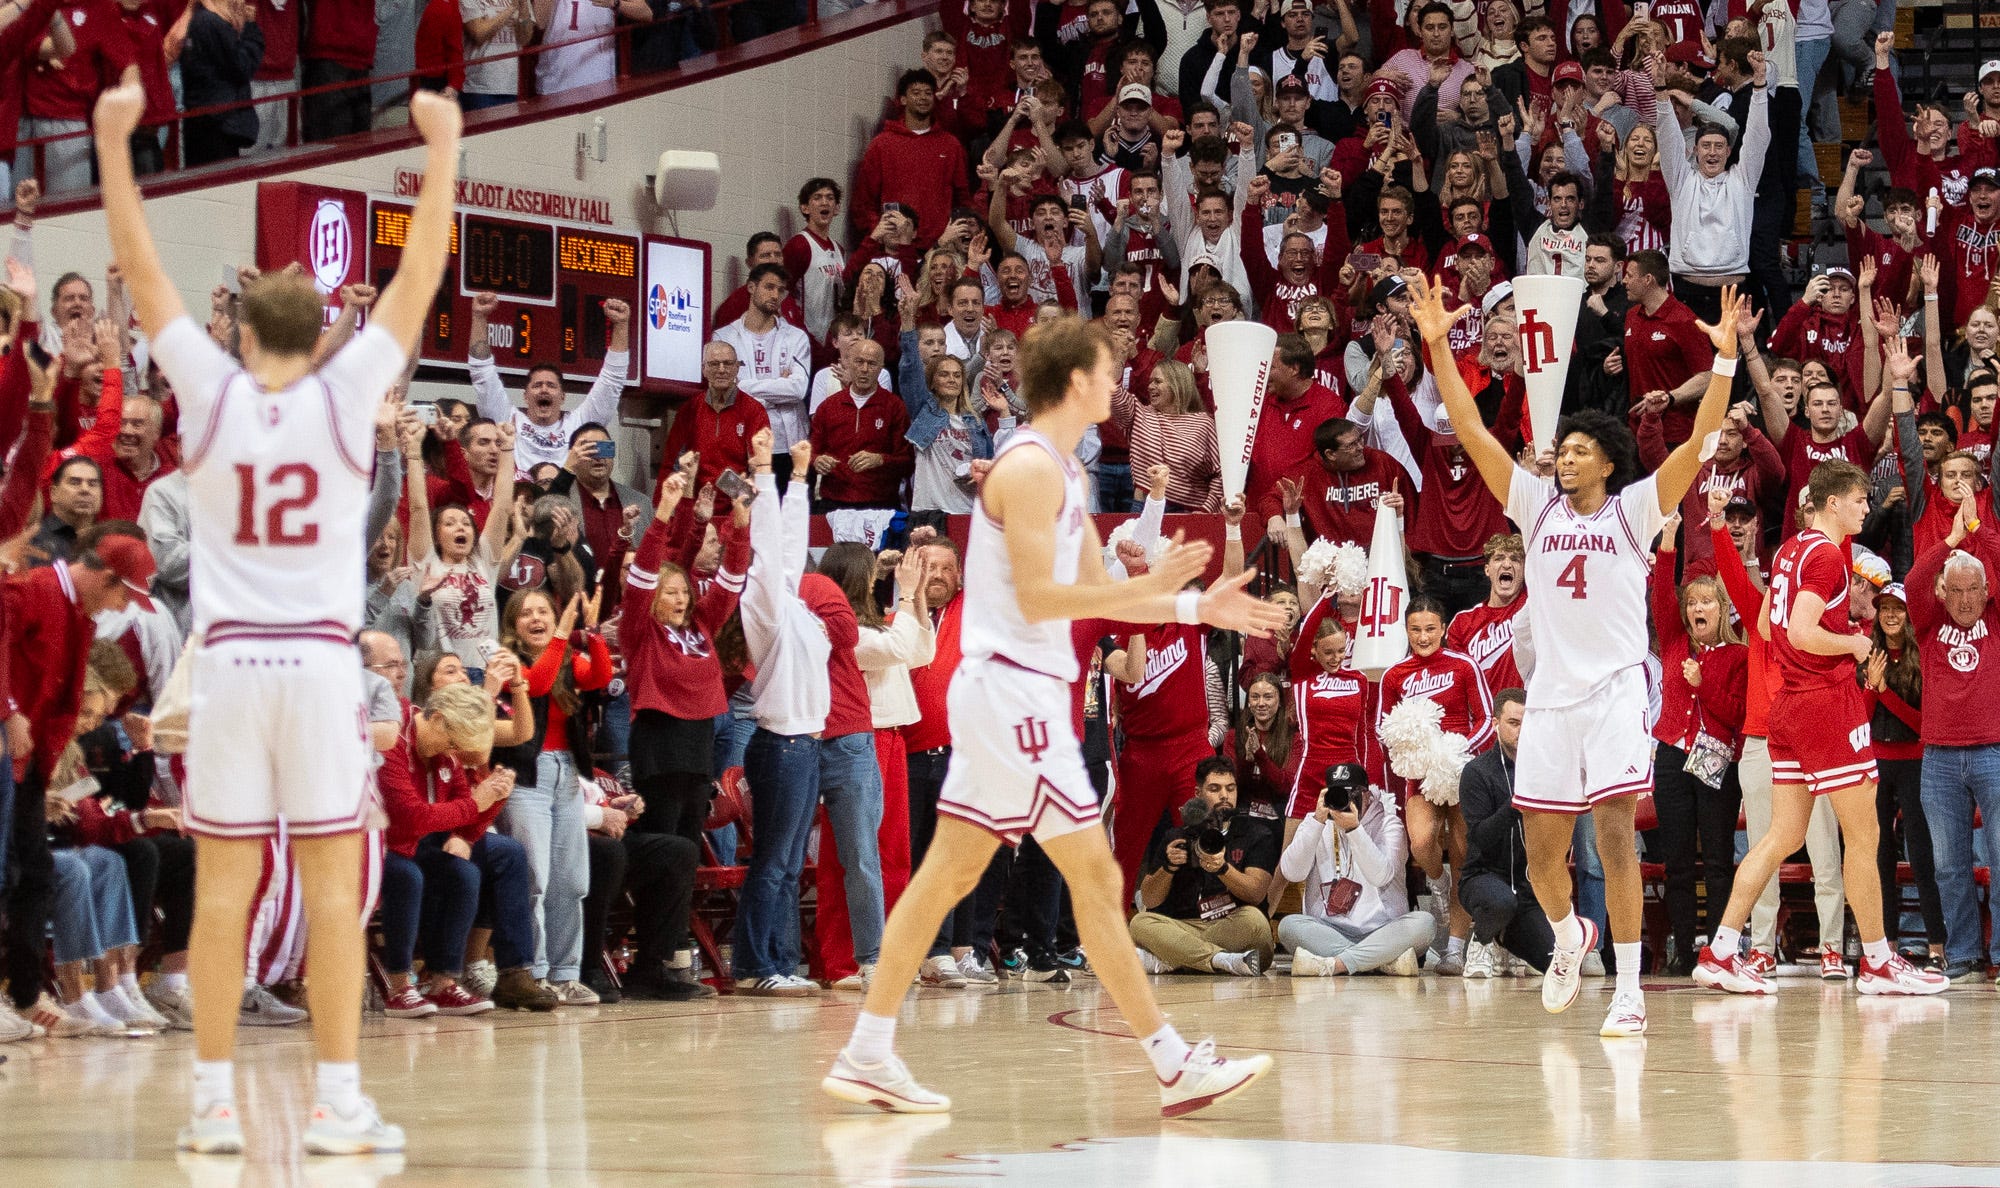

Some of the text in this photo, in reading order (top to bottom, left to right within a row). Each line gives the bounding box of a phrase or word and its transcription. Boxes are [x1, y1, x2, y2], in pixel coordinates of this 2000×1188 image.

[506, 188, 578, 220] ASSEMBLY
[580, 199, 613, 226] HALL
[560, 236, 634, 277] WISCONSIN
[1541, 237, 1583, 252] NDIANA
[649, 297, 667, 318] SPG
[669, 310, 687, 324] Roofing
[488, 323, 514, 349] RIOD
[520, 313, 531, 355] 3
[669, 322, 692, 333] Exteriors
[1241, 360, 1268, 465] TRIED & TRUE
[233, 463, 319, 547] 12
[1326, 482, 1380, 503] HOOSIERS
[1542, 534, 1618, 556] INDIANA
[1556, 554, 1588, 600] 4
[1360, 577, 1403, 638] IU
[1311, 671, 1360, 695] Indiana
[1401, 668, 1455, 698] Indiana
[1013, 716, 1050, 763] IU
[1848, 720, 1871, 753] W
